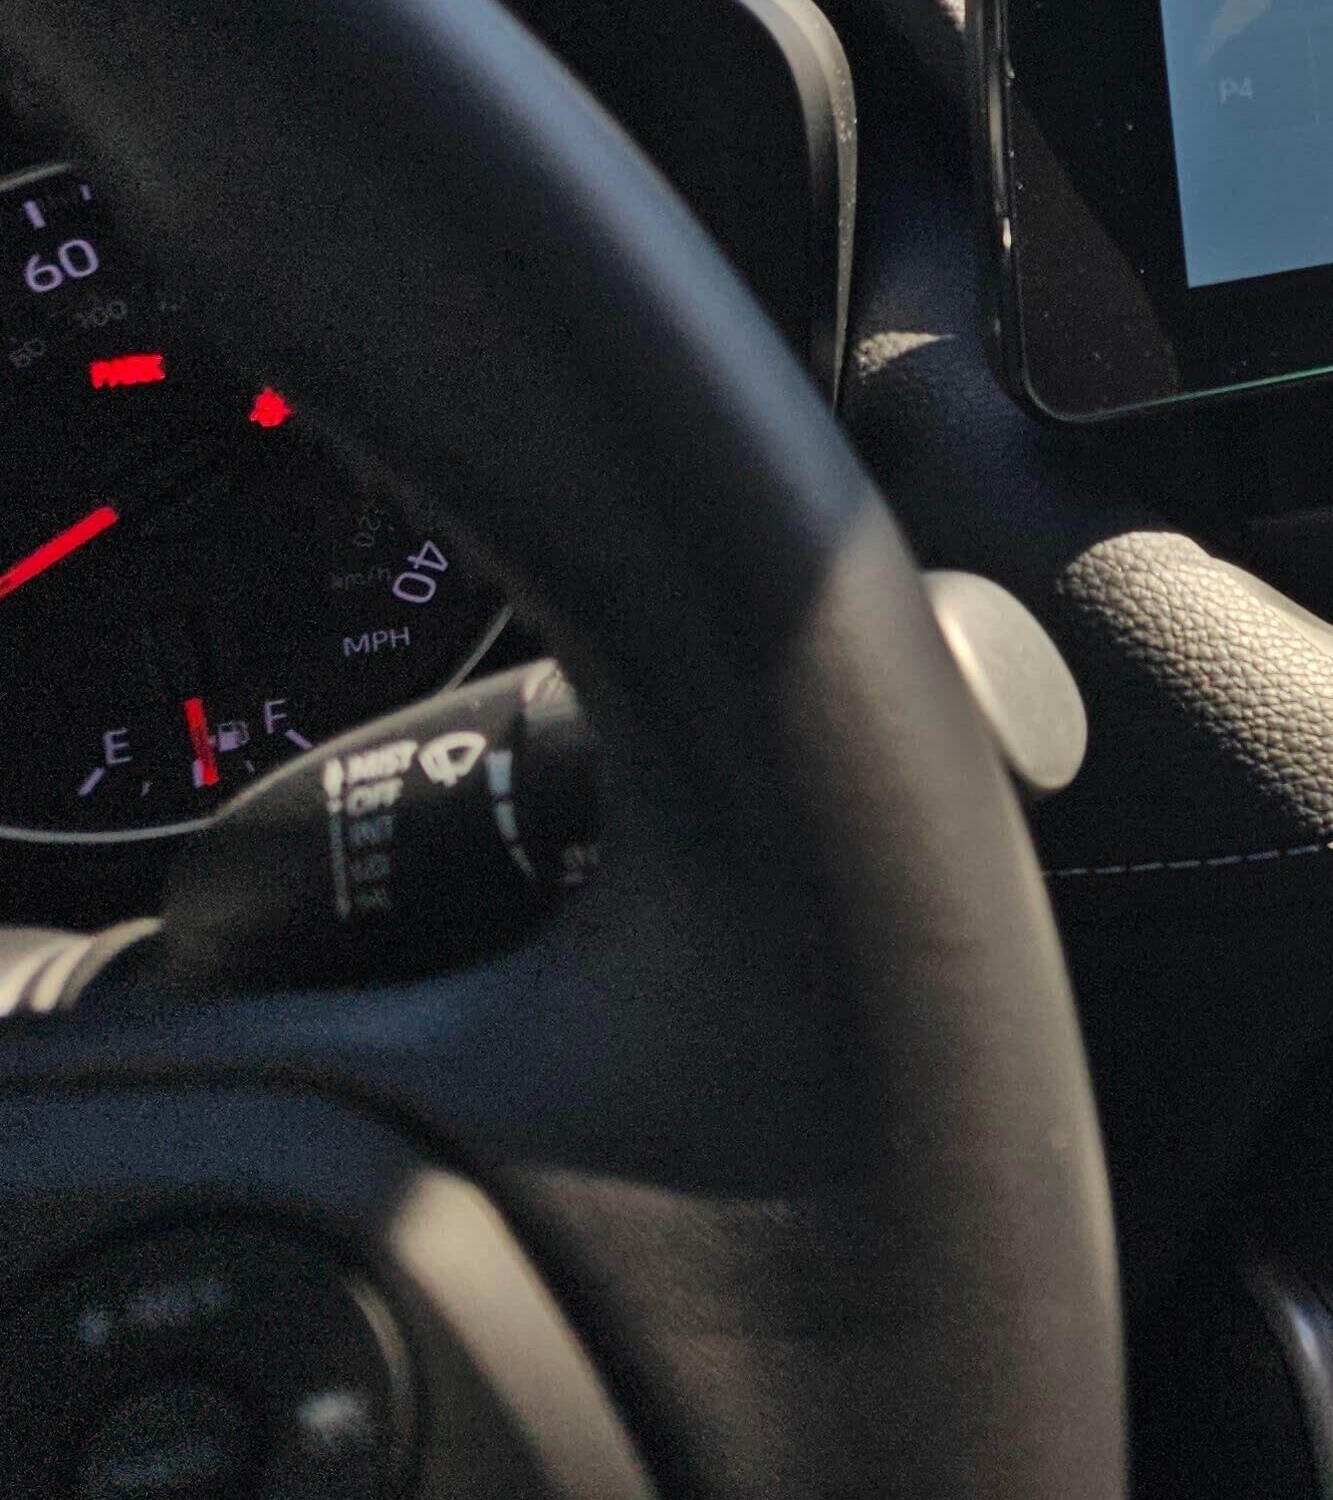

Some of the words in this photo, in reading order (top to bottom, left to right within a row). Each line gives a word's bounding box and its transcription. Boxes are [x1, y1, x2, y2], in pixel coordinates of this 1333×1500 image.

[24, 238, 99, 294] 60
[342, 625, 411, 658] MPH
[263, 699, 289, 734] F
[104, 728, 132, 765] E
